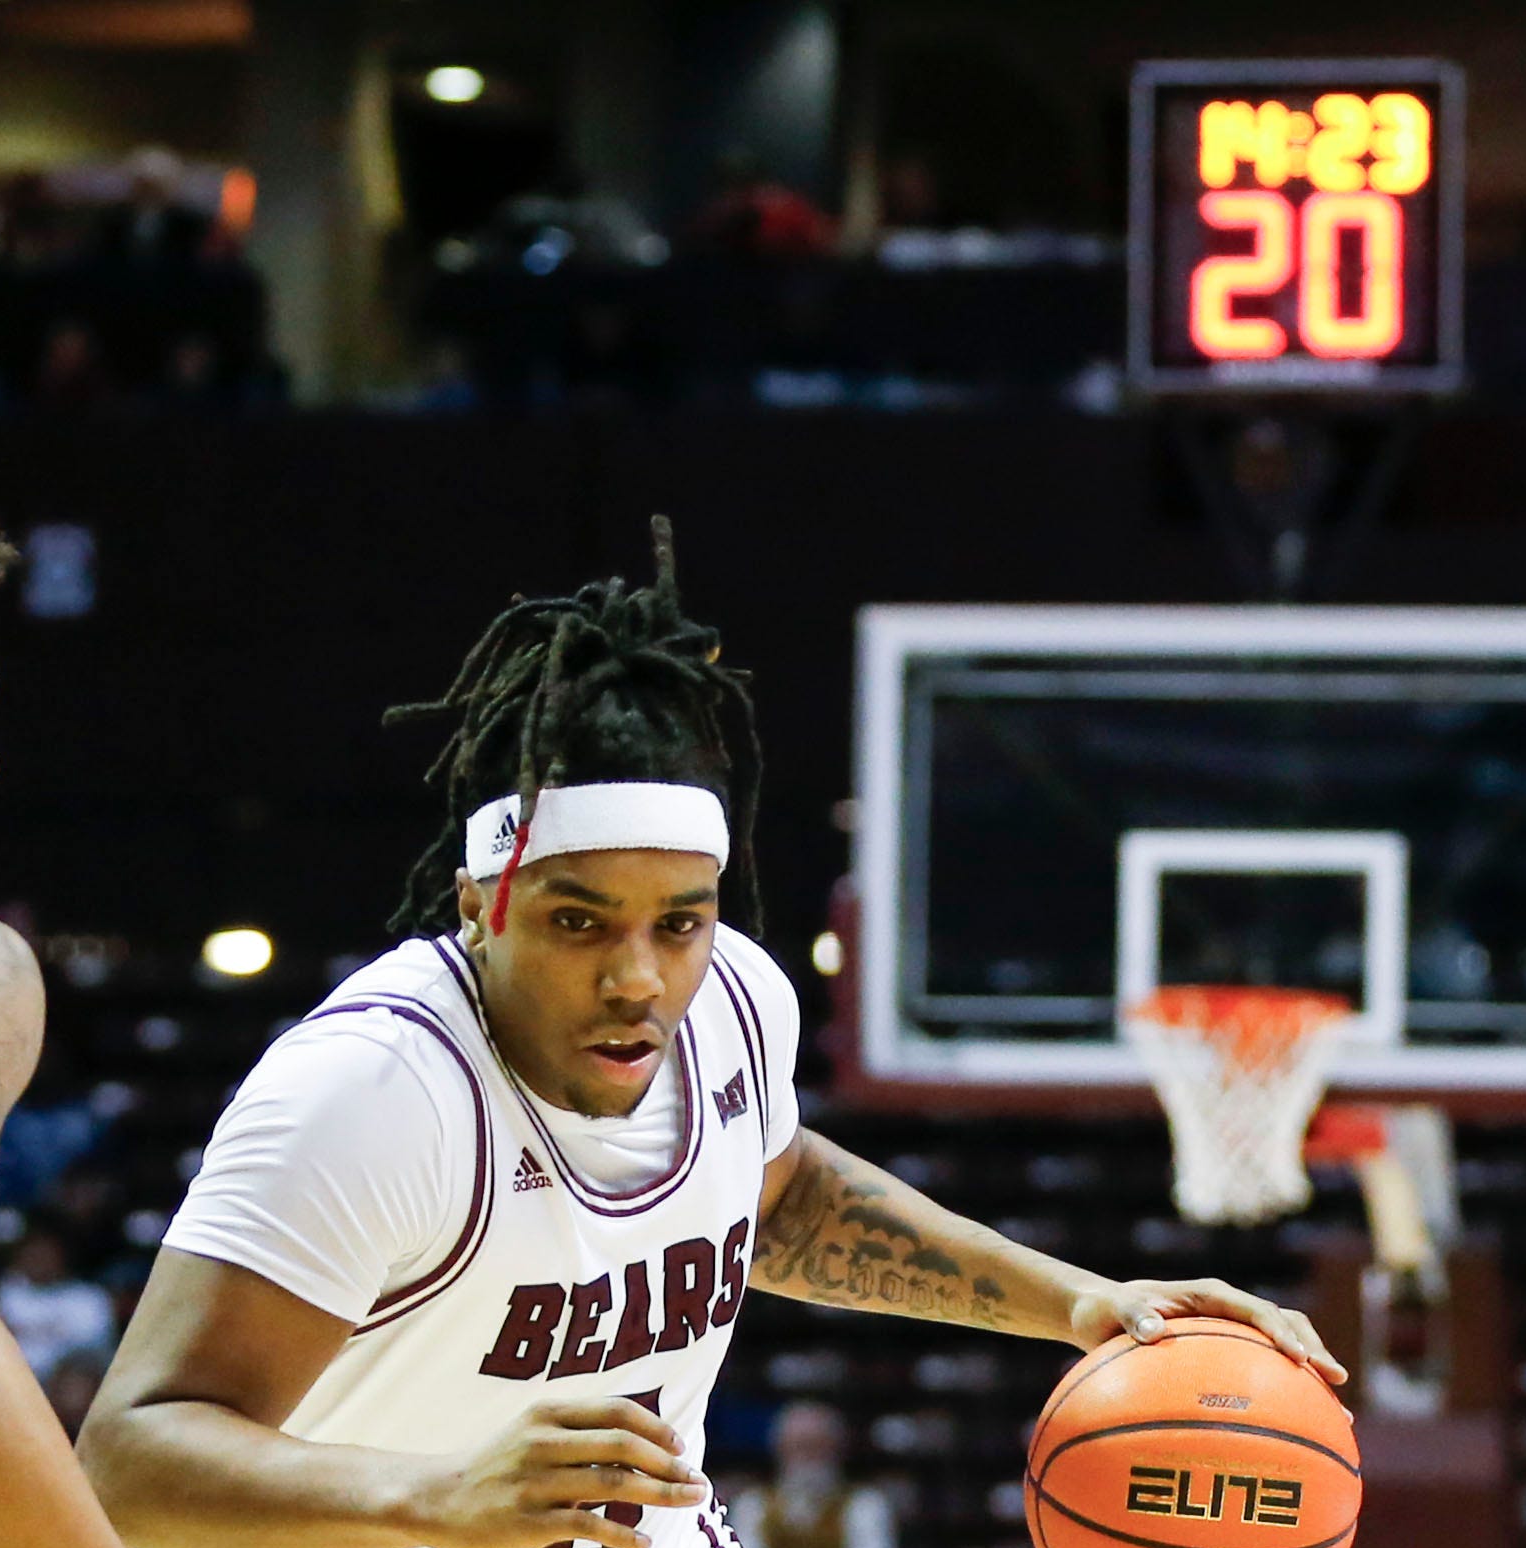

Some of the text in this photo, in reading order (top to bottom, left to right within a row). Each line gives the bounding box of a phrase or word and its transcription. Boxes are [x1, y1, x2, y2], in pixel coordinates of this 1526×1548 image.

[1199, 92, 1431, 195] 14:23
[1190, 189, 1405, 360] 20
[513, 1172, 553, 1192] adidas
[478, 1216, 750, 1382] BEARS
[1126, 1465, 1303, 1528] ELITE
